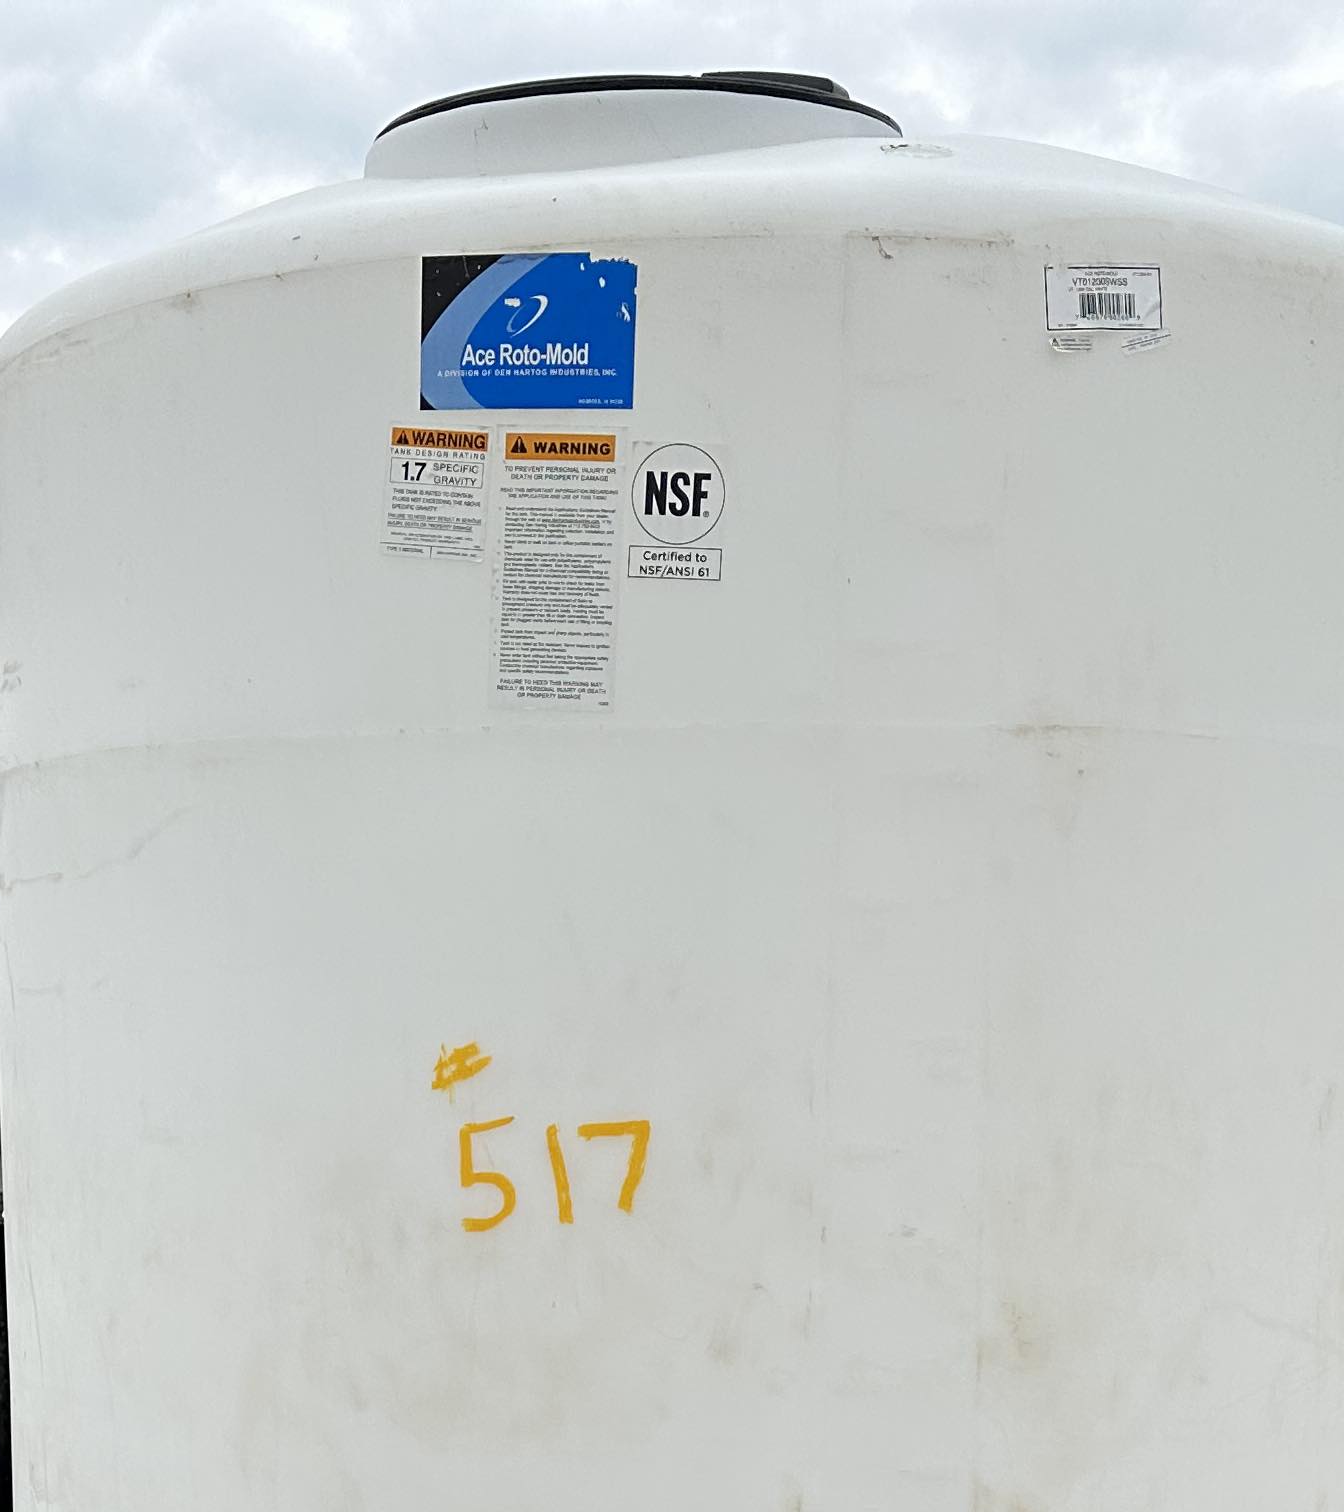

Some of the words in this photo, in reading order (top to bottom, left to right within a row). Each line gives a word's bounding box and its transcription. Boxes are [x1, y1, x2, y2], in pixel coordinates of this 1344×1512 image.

[461, 344, 495, 366] Ace
[500, 342, 589, 366] Roto-Mold
[412, 430, 486, 450] WARNING
[390, 448, 411, 456] TANK
[416, 448, 449, 458] DESIGN
[452, 450, 486, 460] RATING
[534, 442, 610, 456] WARNING
[401, 460, 427, 482] 1.7
[433, 462, 478, 474] SPECIFIC
[434, 475, 476, 486] GRAVITY
[644, 470, 712, 517] NSF
[643, 550, 692, 562] Certified
[695, 552, 707, 562] to
[639, 565, 694, 577] NSF/ANSI
[698, 568, 710, 577] 61
[459, 1115, 651, 1232] 517
